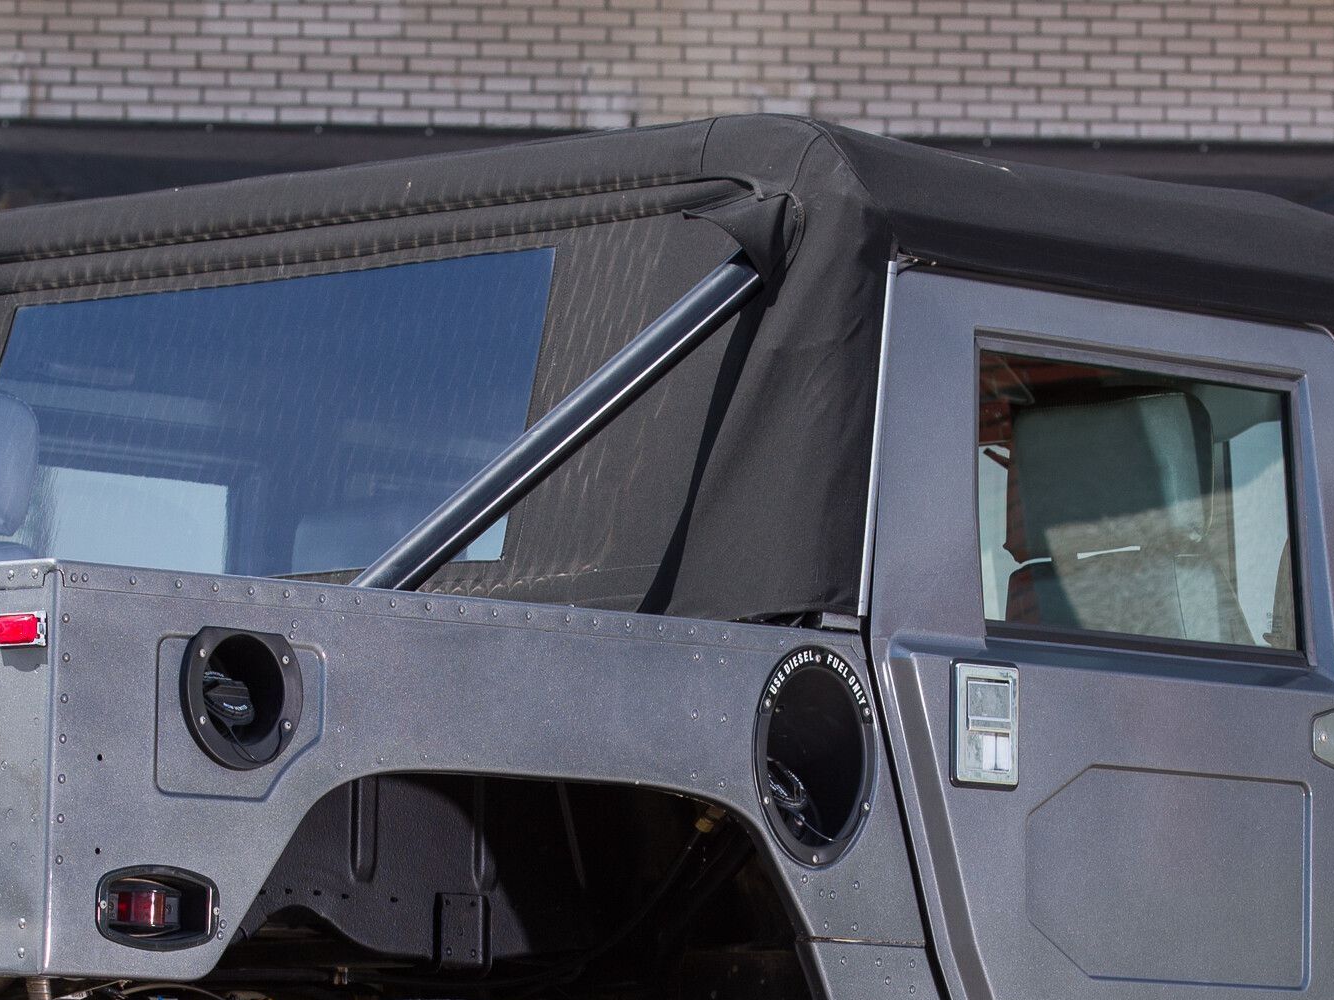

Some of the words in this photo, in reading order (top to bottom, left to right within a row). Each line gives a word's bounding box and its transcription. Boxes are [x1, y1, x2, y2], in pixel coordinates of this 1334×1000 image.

[769, 671, 785, 694] USE
[784, 650, 814, 674] DIESEL
[827, 654, 848, 678] FUEL
[849, 676, 866, 704] ONLY
